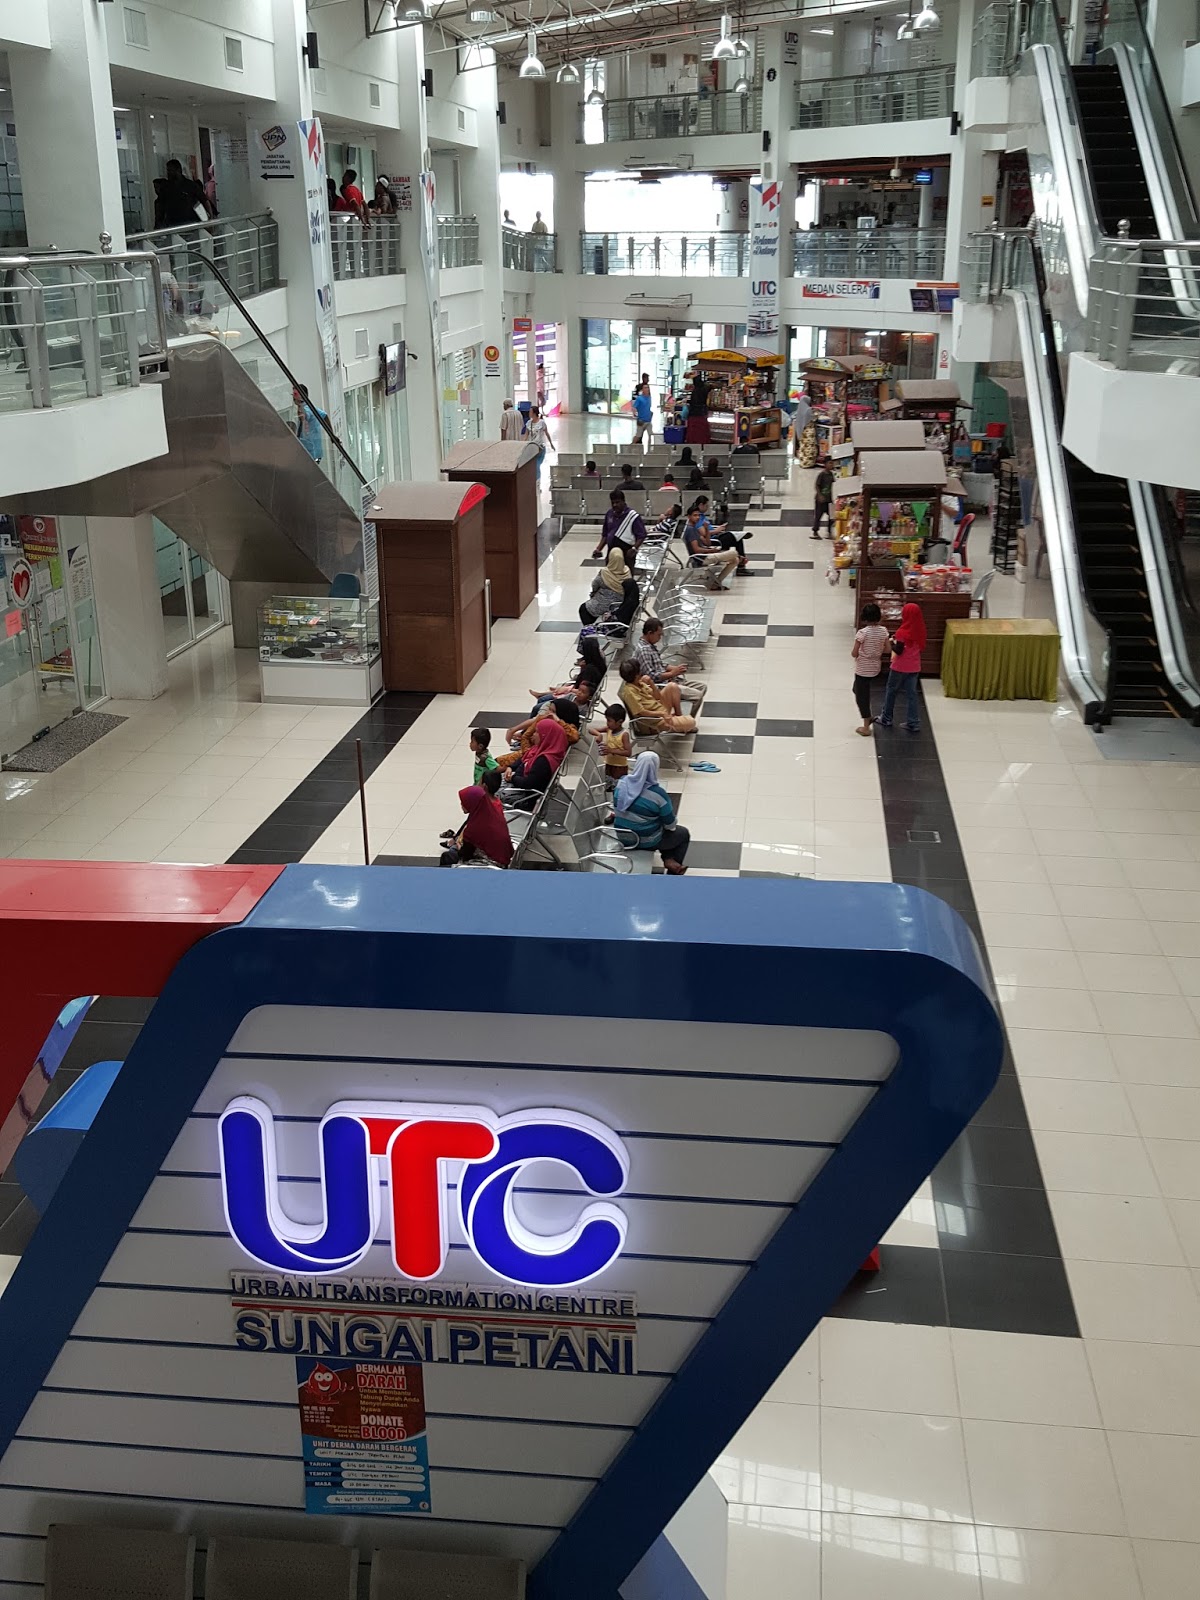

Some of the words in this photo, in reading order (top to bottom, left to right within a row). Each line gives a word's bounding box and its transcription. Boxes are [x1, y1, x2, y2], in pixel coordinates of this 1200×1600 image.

[785, 31, 798, 44] UTC
[752, 280, 777, 296] UTC
[806, 284, 834, 294] MEDAN
[836, 284, 868, 295] SELERA
[218, 1096, 631, 1288] UTC
[231, 1274, 315, 1298] URBAN
[318, 1280, 534, 1311] TRANSFORMATION
[539, 1293, 637, 1316] CENTRE
[235, 1314, 434, 1362] SUNGAI
[449, 1326, 635, 1375] PETANI
[356, 1364, 405, 1375] DERMALAH
[357, 1373, 407, 1391] DARAH
[360, 1414, 404, 1427] DONATE
[361, 1425, 407, 1441] BLOOD
[312, 1440, 329, 1448] UNIT
[330, 1441, 355, 1449] DERMA
[356, 1442, 380, 1450] DARAH
[381, 1444, 417, 1453] BERGERAK
